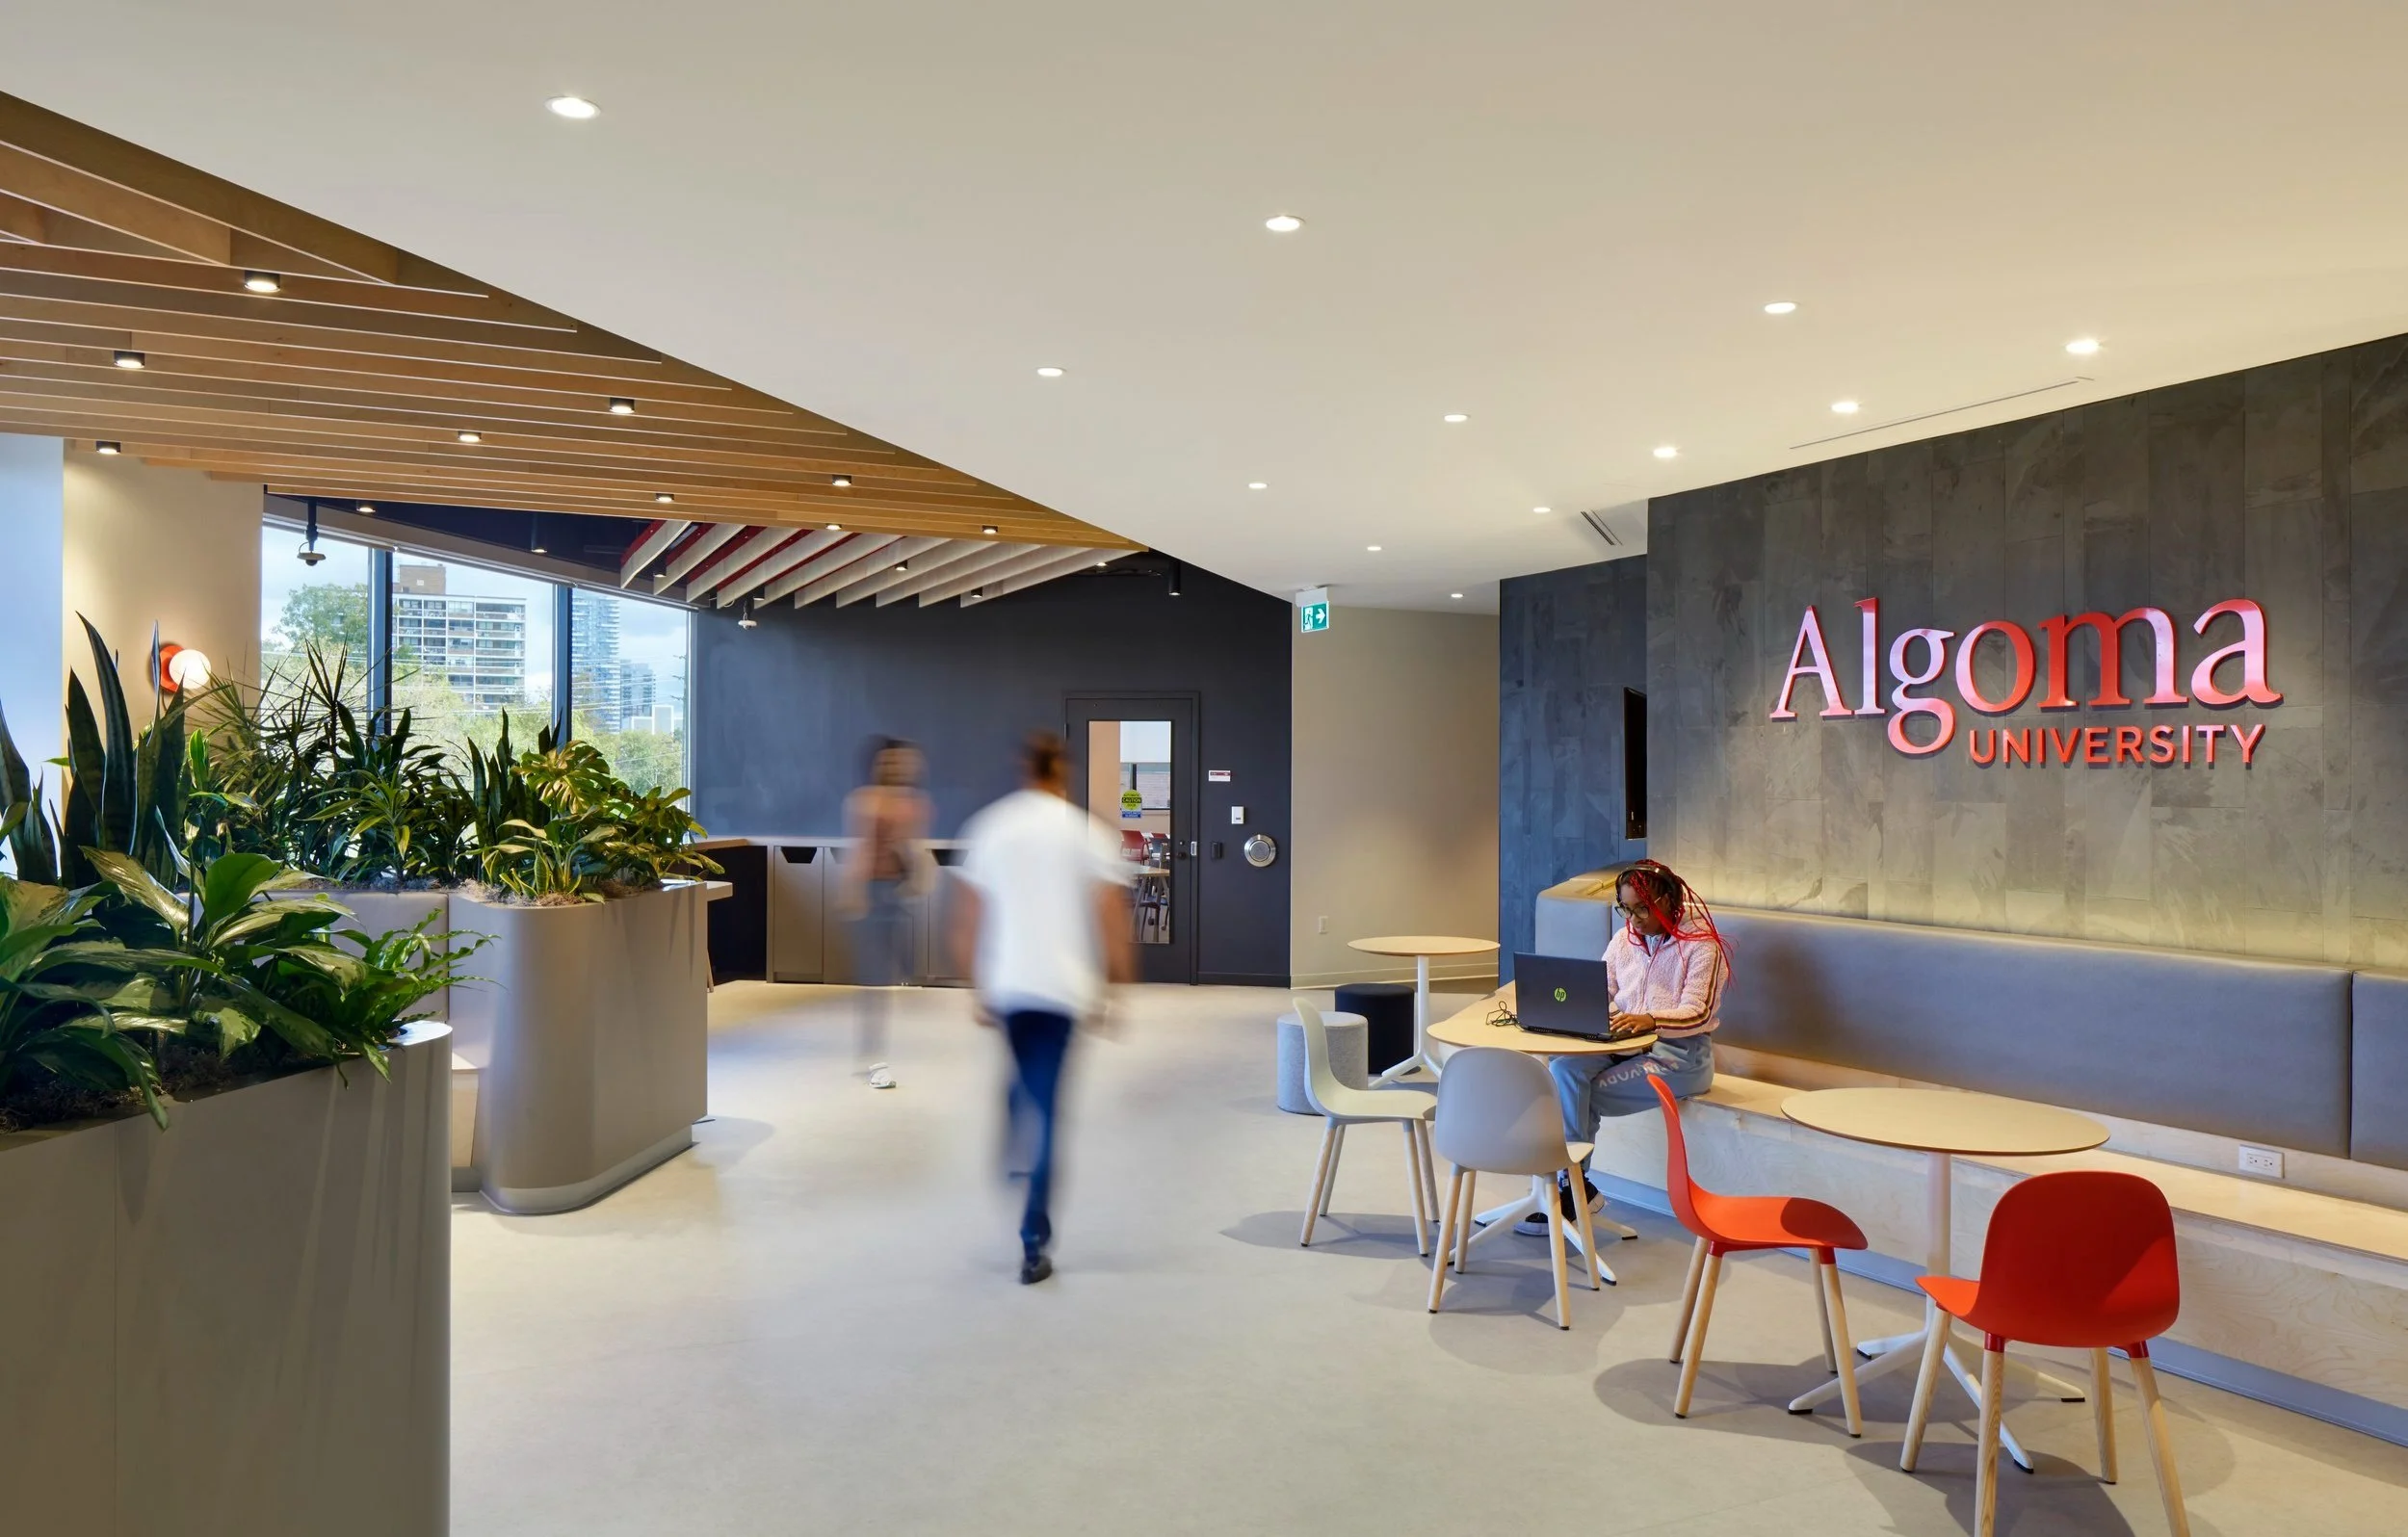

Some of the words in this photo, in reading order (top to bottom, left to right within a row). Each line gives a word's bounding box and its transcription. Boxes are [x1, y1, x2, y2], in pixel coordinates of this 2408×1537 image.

[1769, 597, 2284, 754] Algoma
[1969, 723, 2266, 766] UNIVERSITY
[1556, 987, 1565, 1002] hp
